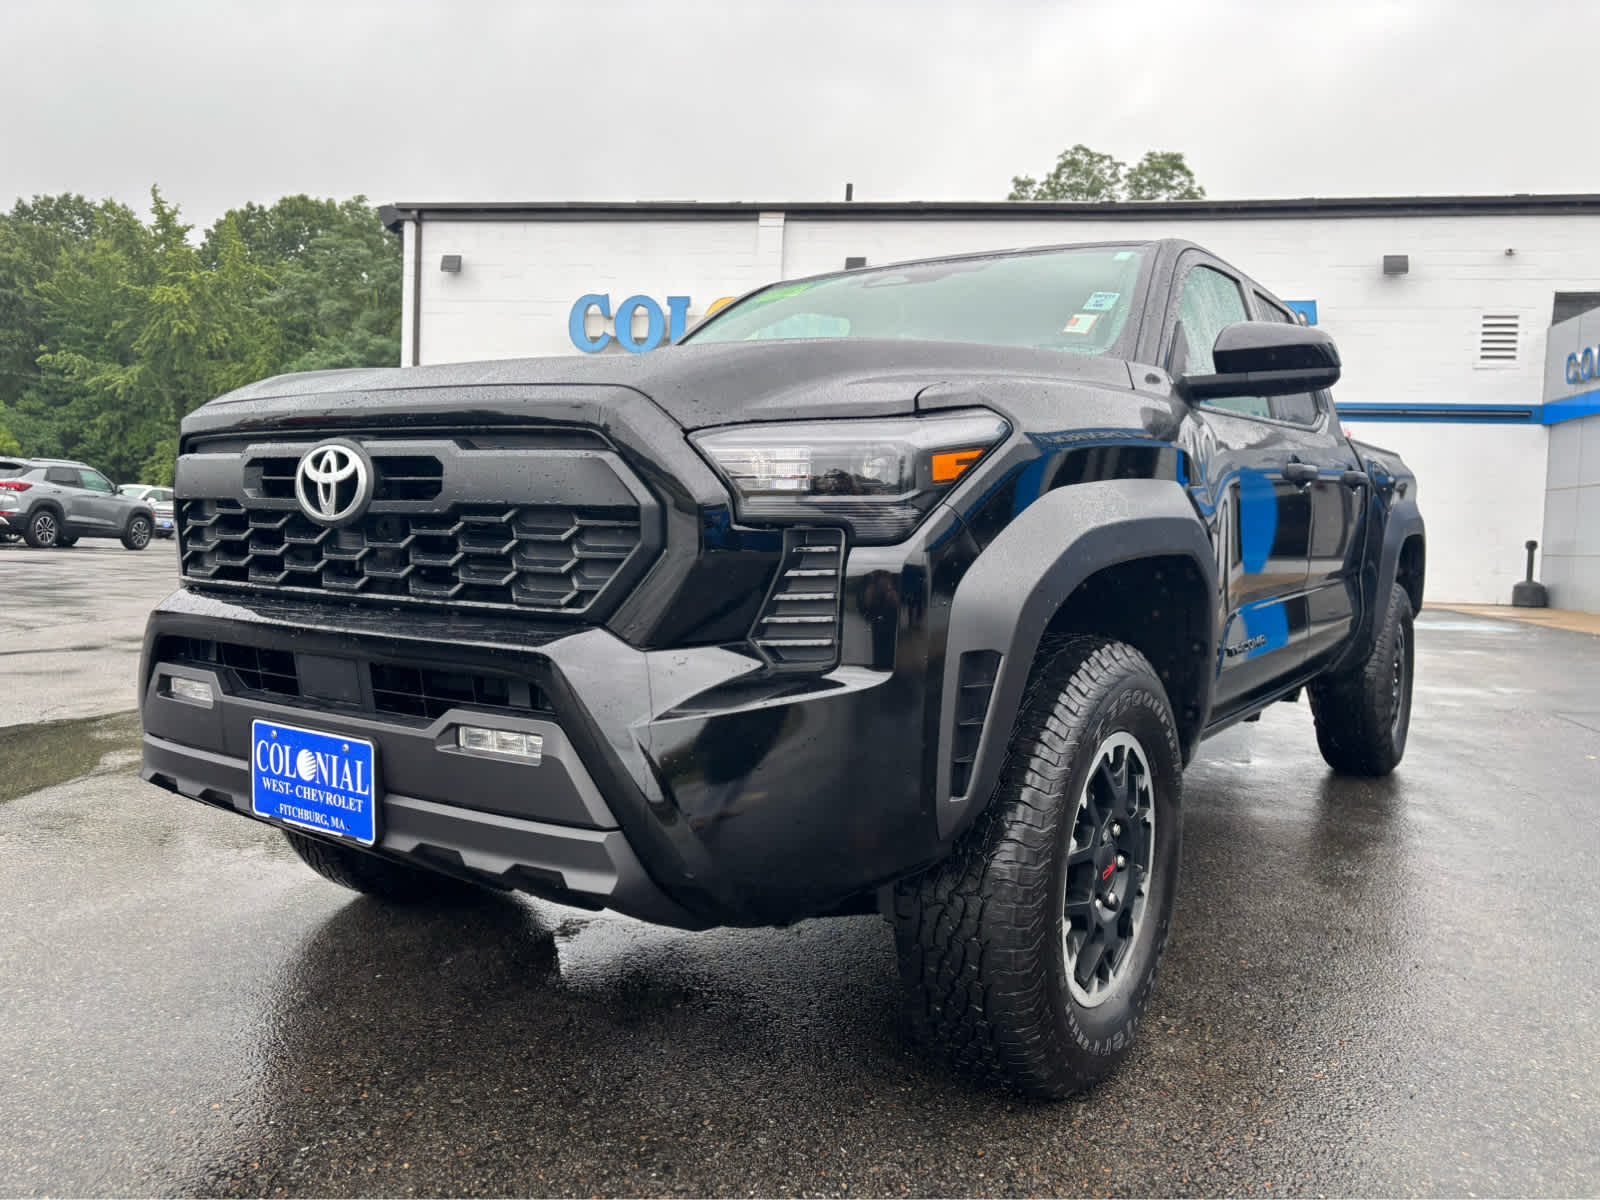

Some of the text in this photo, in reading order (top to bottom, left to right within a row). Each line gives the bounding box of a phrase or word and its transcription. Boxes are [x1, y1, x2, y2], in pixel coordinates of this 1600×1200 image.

[1566, 344, 1600, 385] CO
[256, 739, 370, 796] COLONIAL
[295, 784, 364, 813] CHEVROLET
[279, 803, 346, 830] FITCHBURG, MA
